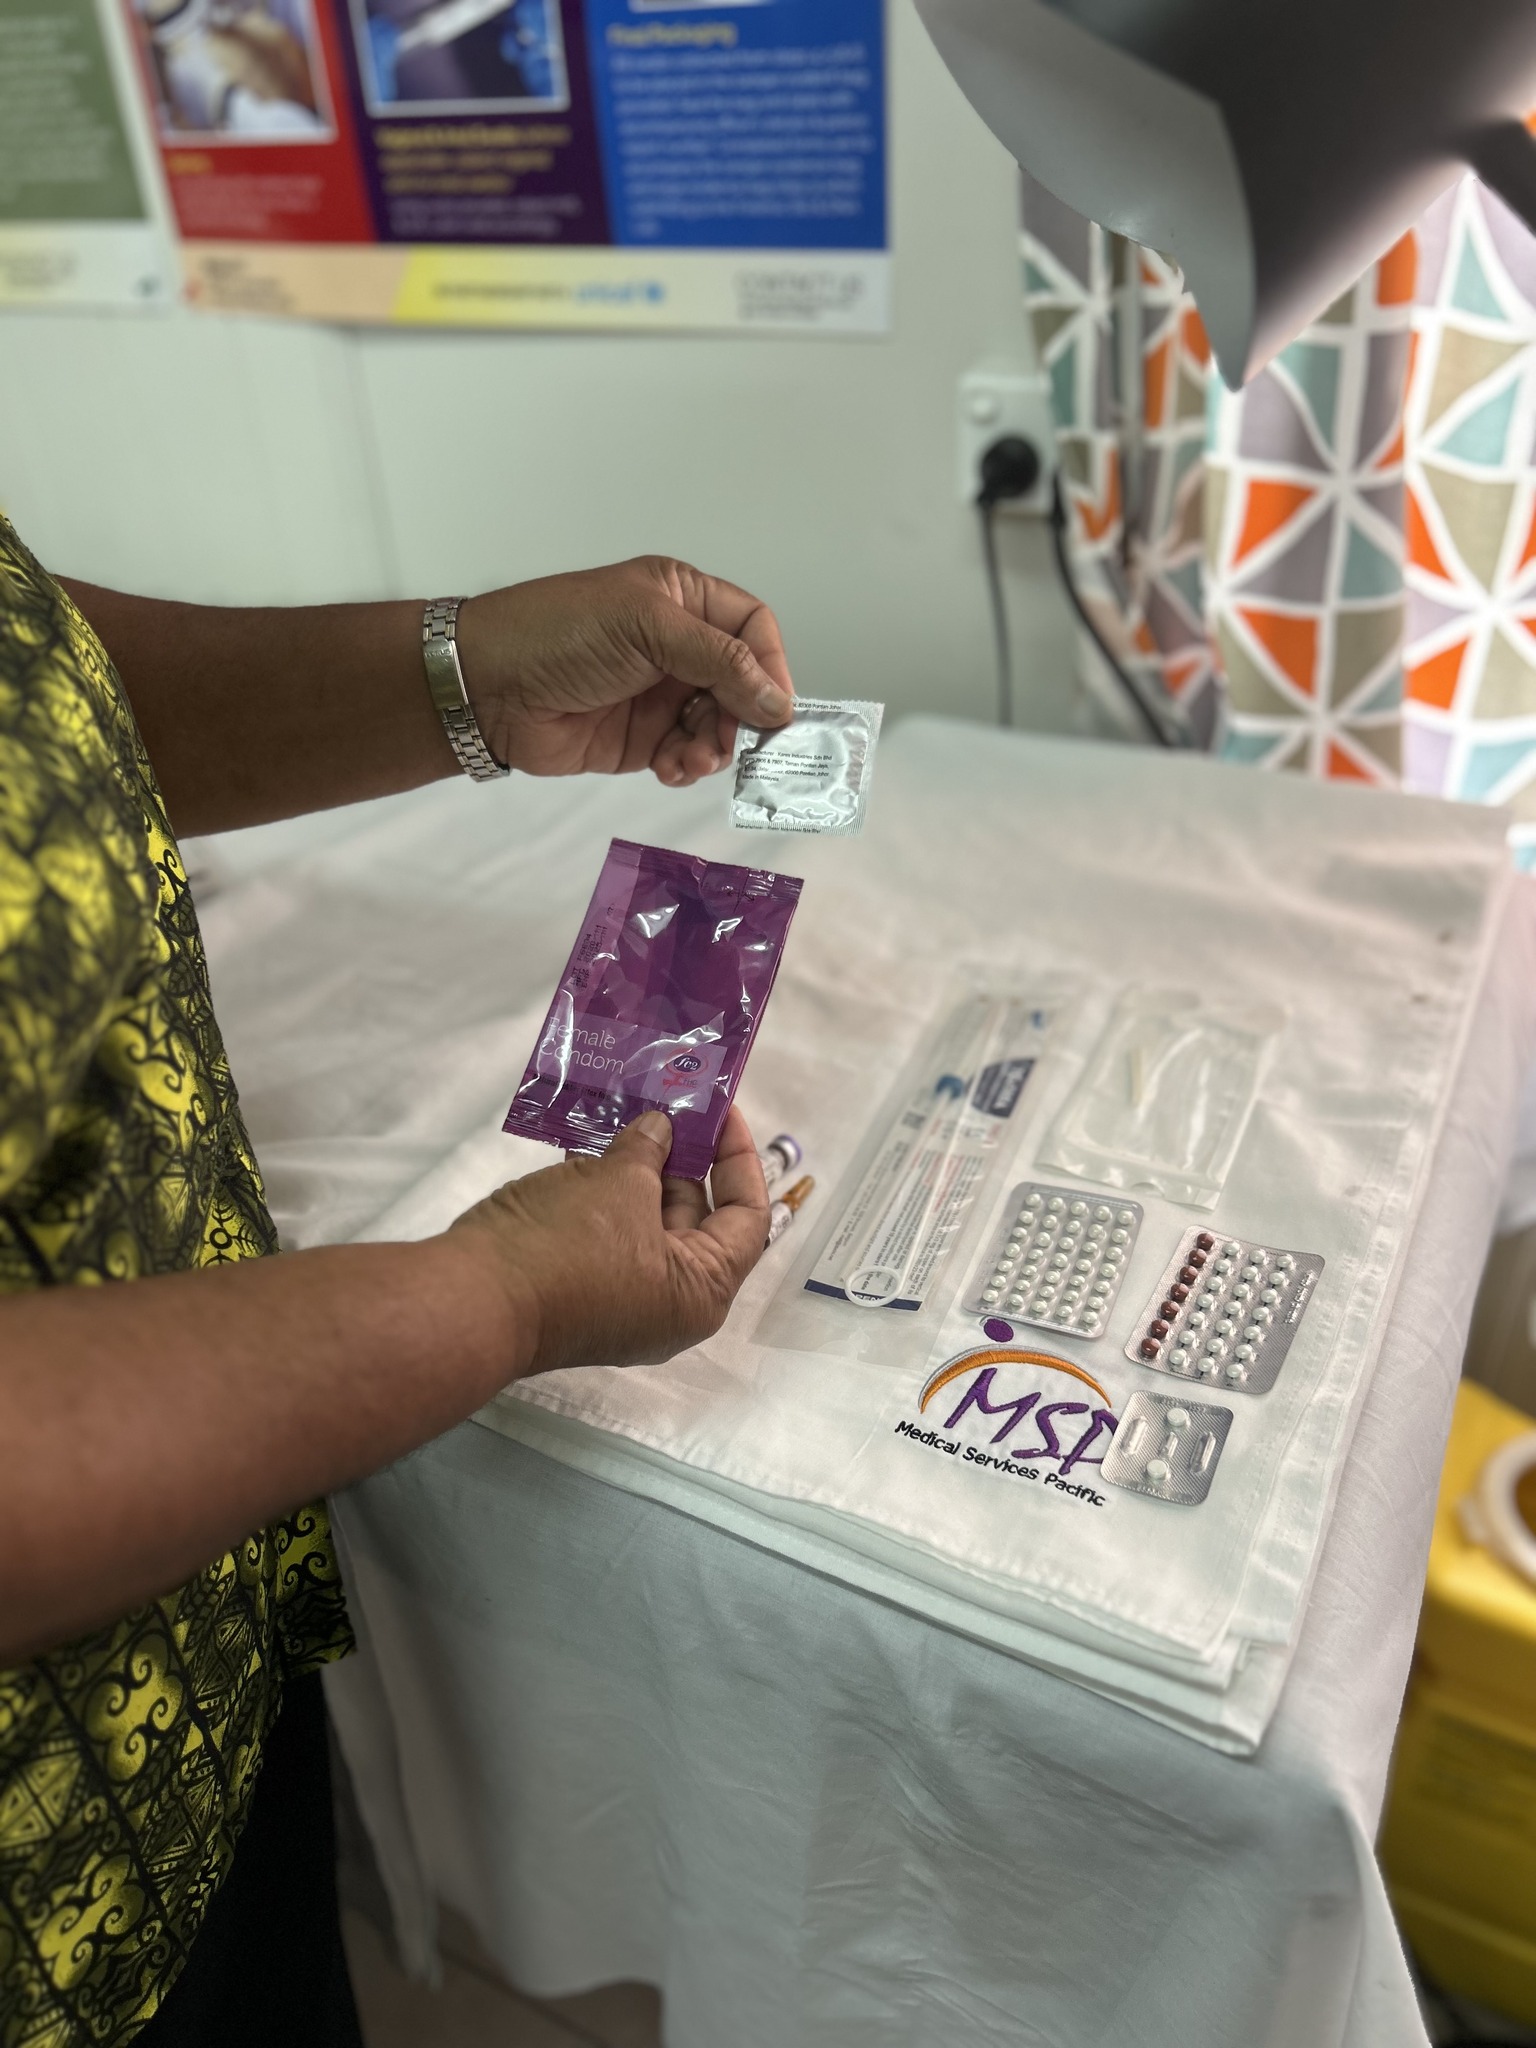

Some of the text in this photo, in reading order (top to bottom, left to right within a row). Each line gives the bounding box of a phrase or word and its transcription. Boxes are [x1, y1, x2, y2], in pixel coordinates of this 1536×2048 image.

[547, 1016, 616, 1050] Female
[541, 1040, 624, 1074] Condom
[894, 1420, 1107, 1507] Medical Services Pacific
